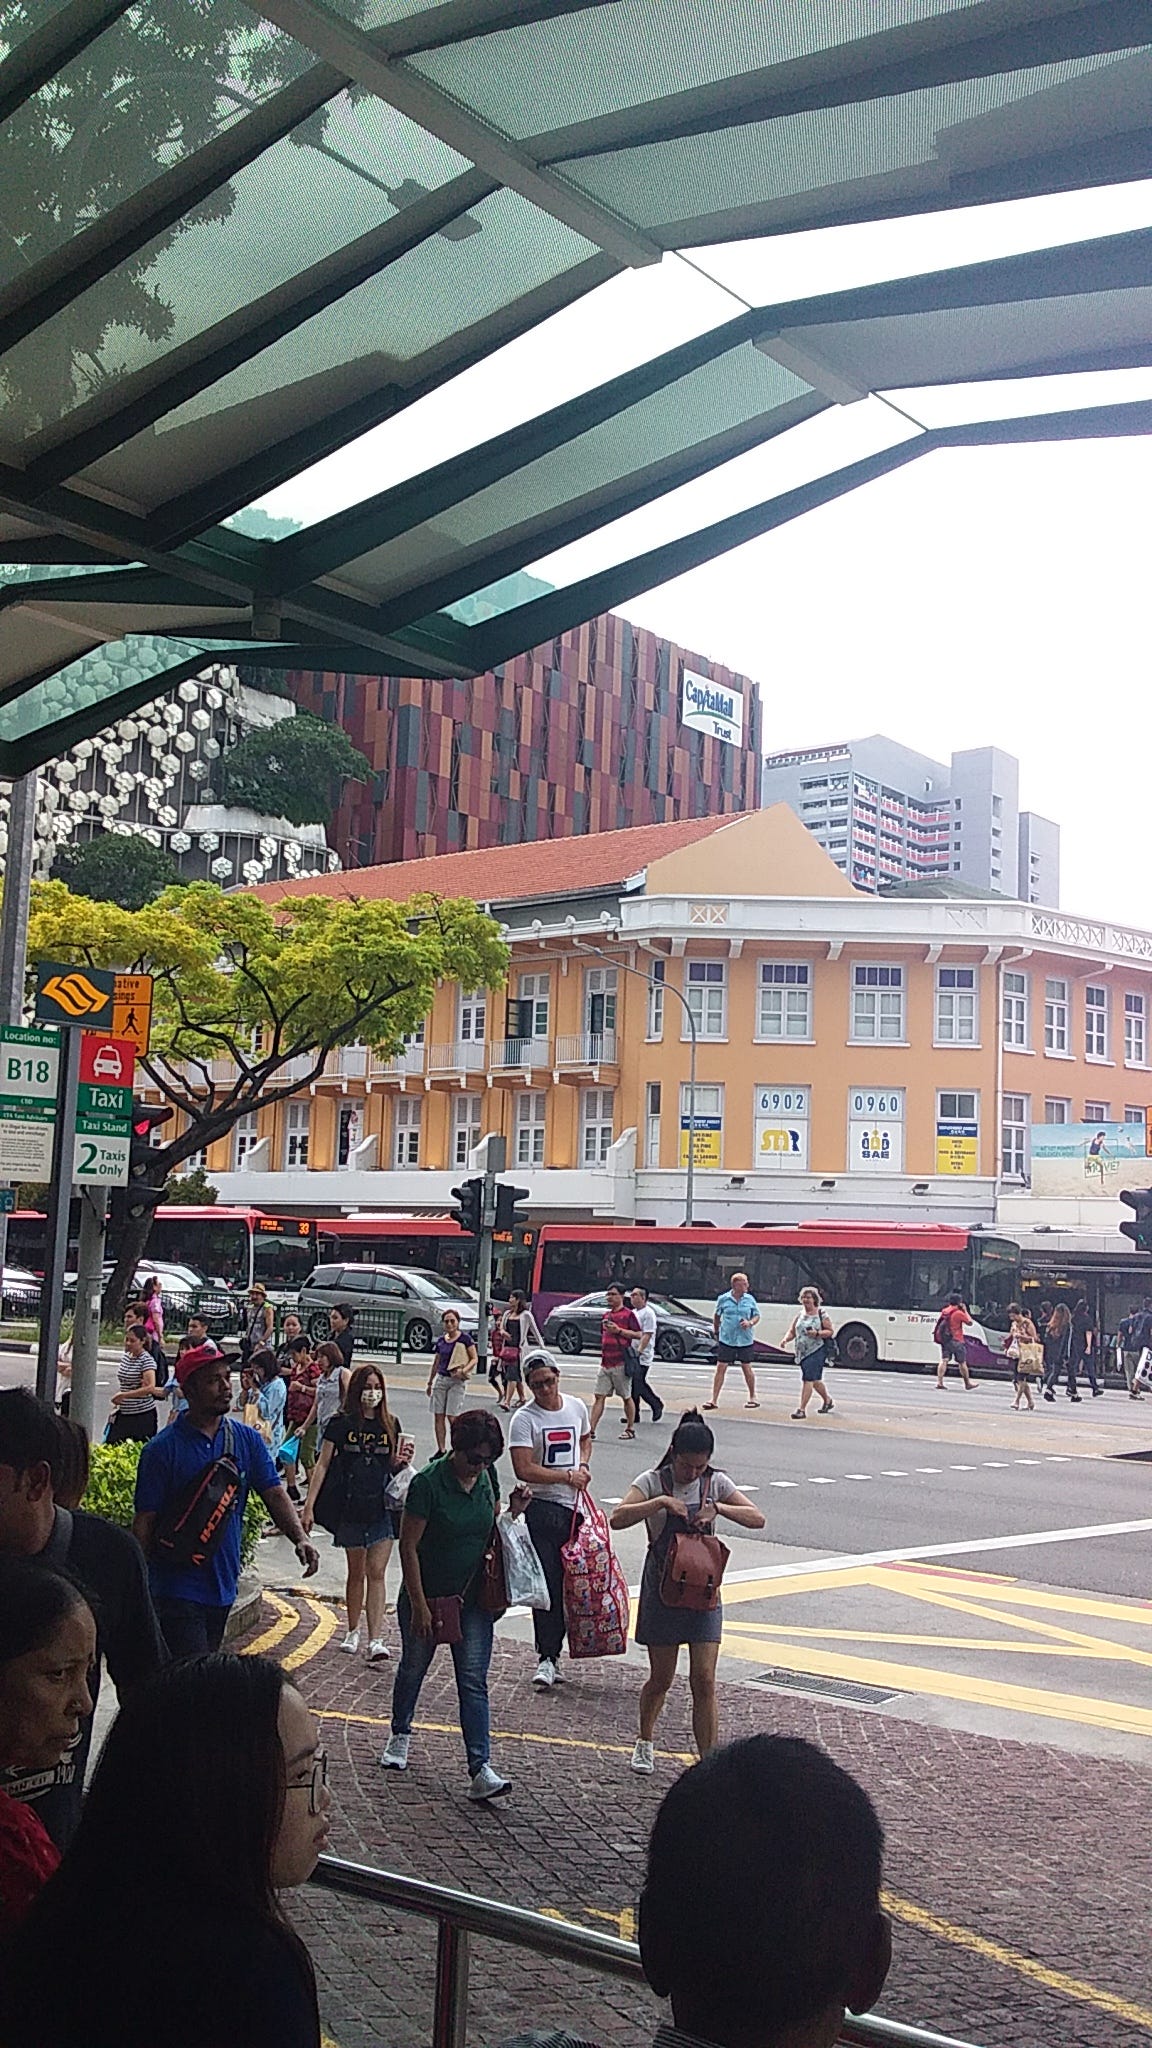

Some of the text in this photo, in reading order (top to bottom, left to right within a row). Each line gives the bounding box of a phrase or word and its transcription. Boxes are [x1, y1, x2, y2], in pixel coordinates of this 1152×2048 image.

[685, 679, 734, 719] CapitaMall
[712, 720, 732, 741] Trust
[4, 1030, 57, 1045] Location no:
[7, 1057, 50, 1084] B18
[88, 1087, 124, 1109] Taxi
[761, 1093, 898, 1112] 6902 0960
[82, 1119, 128, 1133] Taxi Stand
[77, 1142, 98, 1175] 2
[100, 1149, 126, 1162] Taxis
[861, 1150, 890, 1159] SAE
[99, 1163, 123, 1178] Only
[298, 1222, 310, 1235] 33
[907, 1314, 938, 1324] SBS Trans
